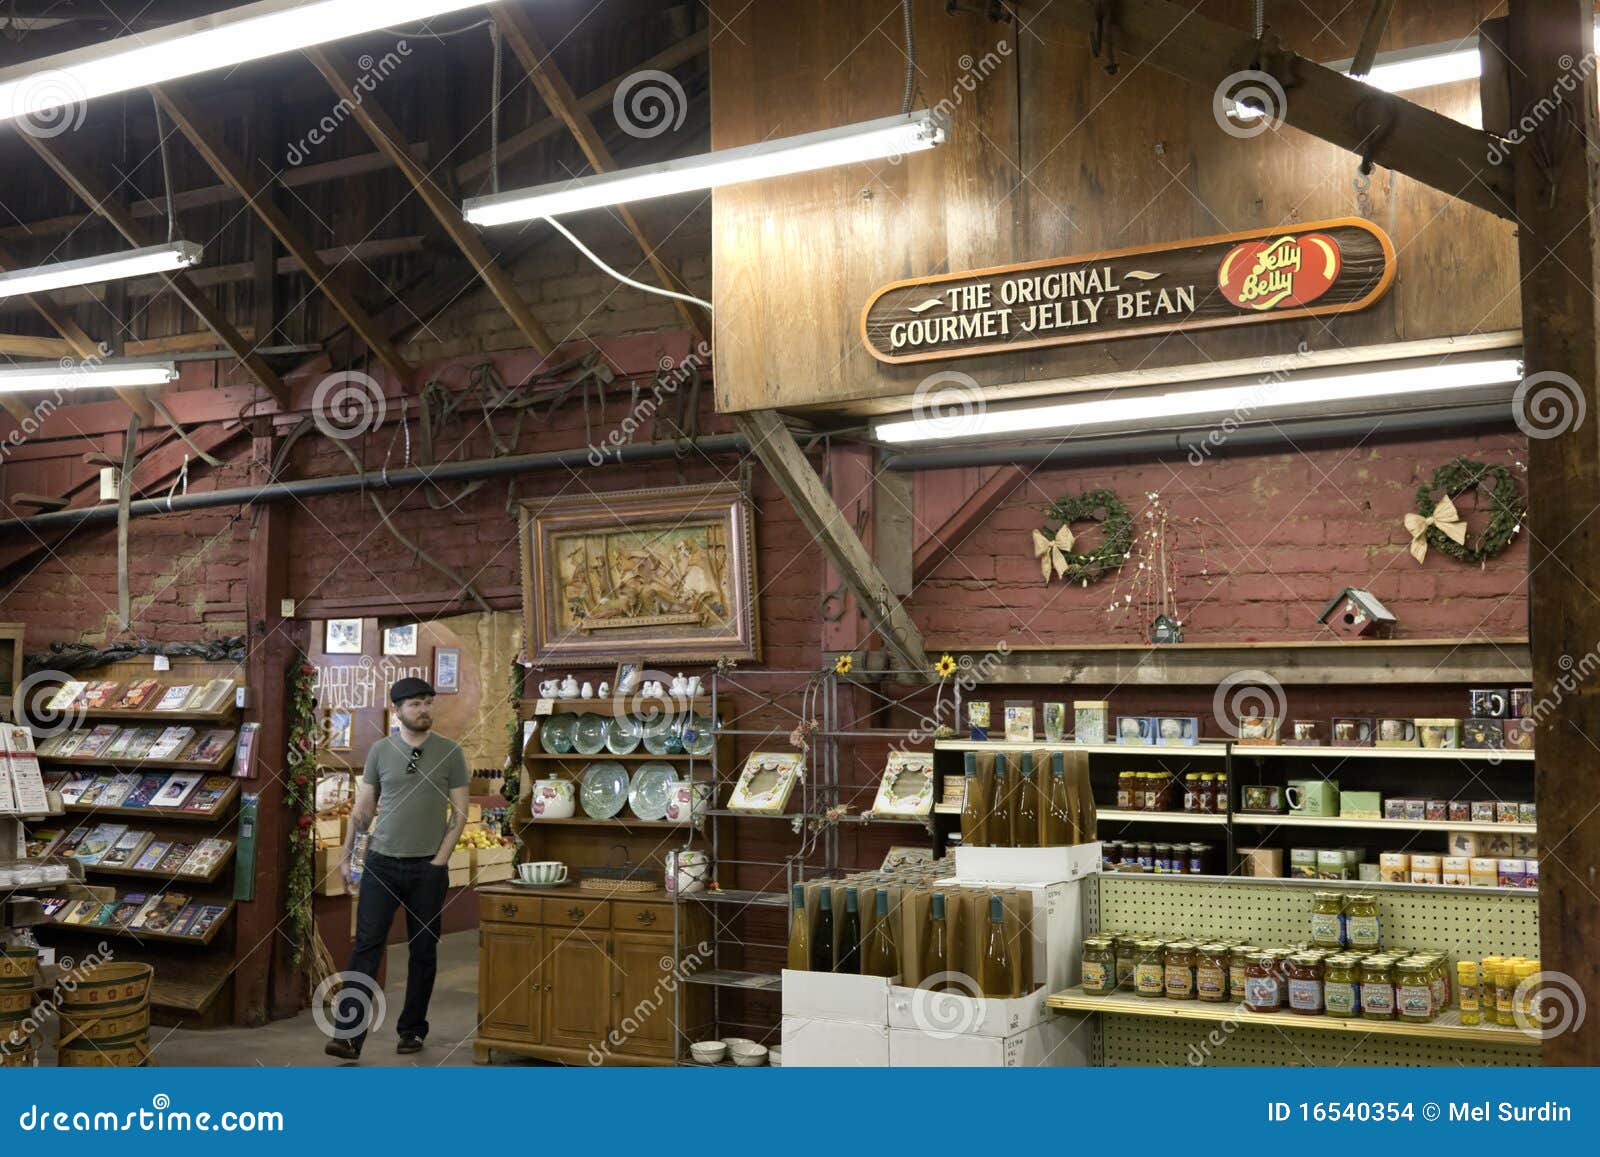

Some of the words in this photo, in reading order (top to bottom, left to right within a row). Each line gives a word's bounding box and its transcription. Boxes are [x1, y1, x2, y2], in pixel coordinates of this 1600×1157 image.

[1252, 243, 1302, 273] Jelly
[947, 283, 992, 312] THE
[1001, 266, 1120, 306] ORIGINAL
[1238, 269, 1293, 304] Belly
[890, 308, 1012, 348] GOURMET
[1021, 296, 1104, 332] JELLY
[1116, 285, 1195, 320] BEAN
